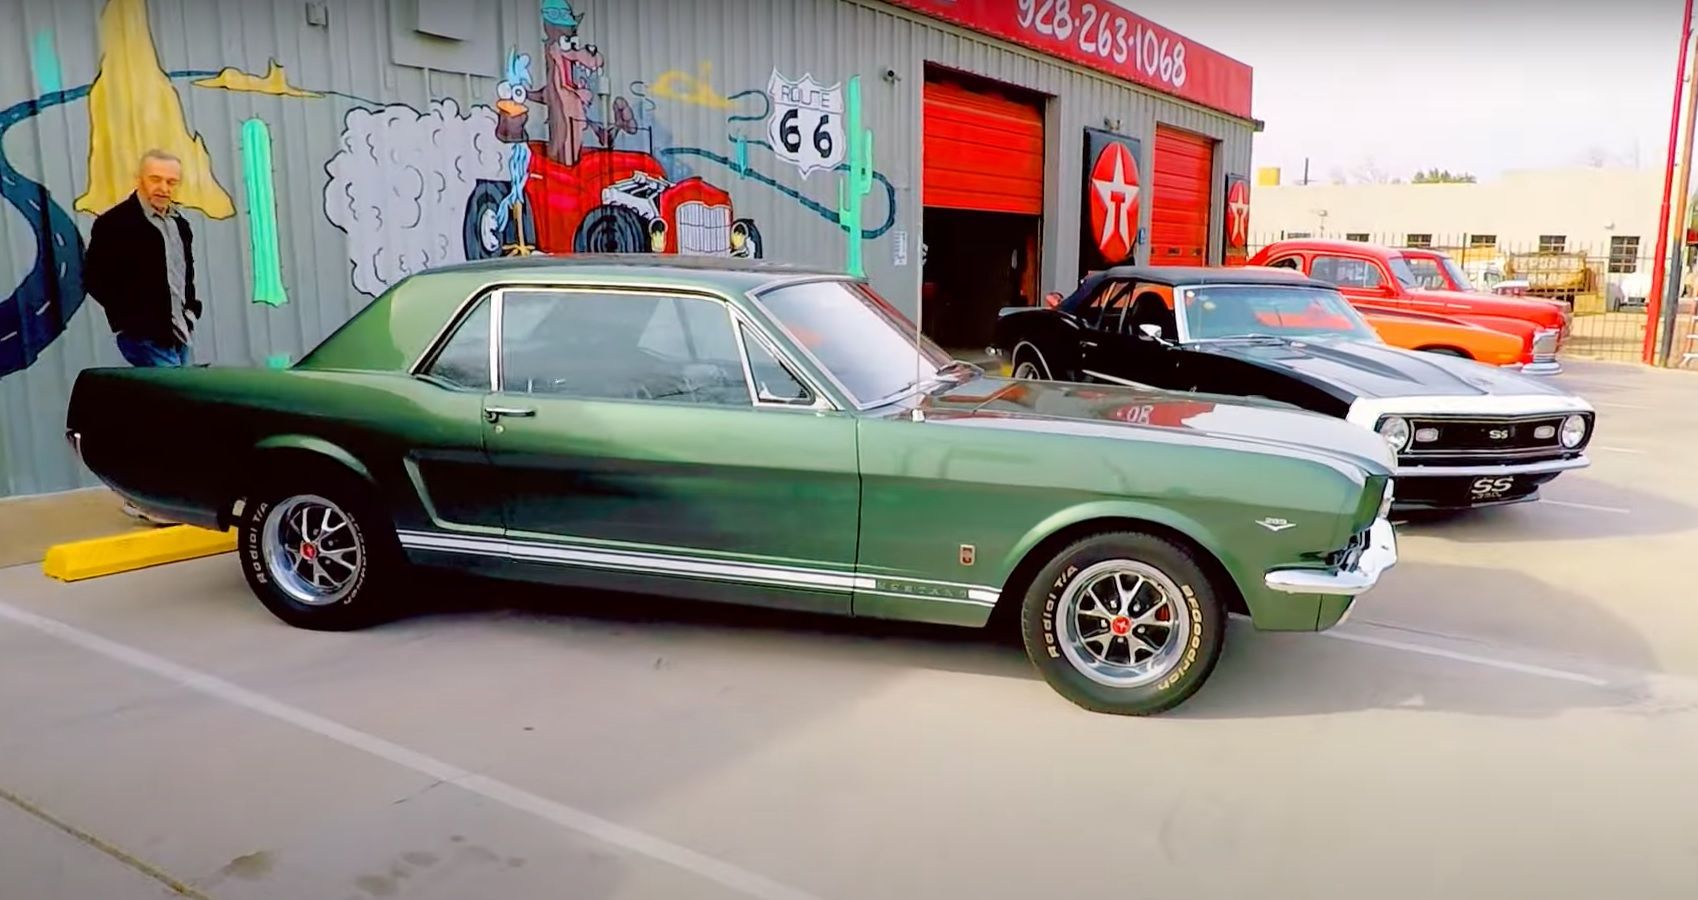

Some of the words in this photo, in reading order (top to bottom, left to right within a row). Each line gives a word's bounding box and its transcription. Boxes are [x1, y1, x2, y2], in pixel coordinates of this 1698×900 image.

[780, 84, 831, 108] ROUTE
[779, 109, 833, 159] 66
[1489, 429, 1509, 440] SS
[1471, 477, 1514, 494] SS
[252, 502, 269, 523] T/A
[248, 527, 268, 585] Radial
[1040, 592, 1061, 659] Radial
[1053, 564, 1080, 589] T/A
